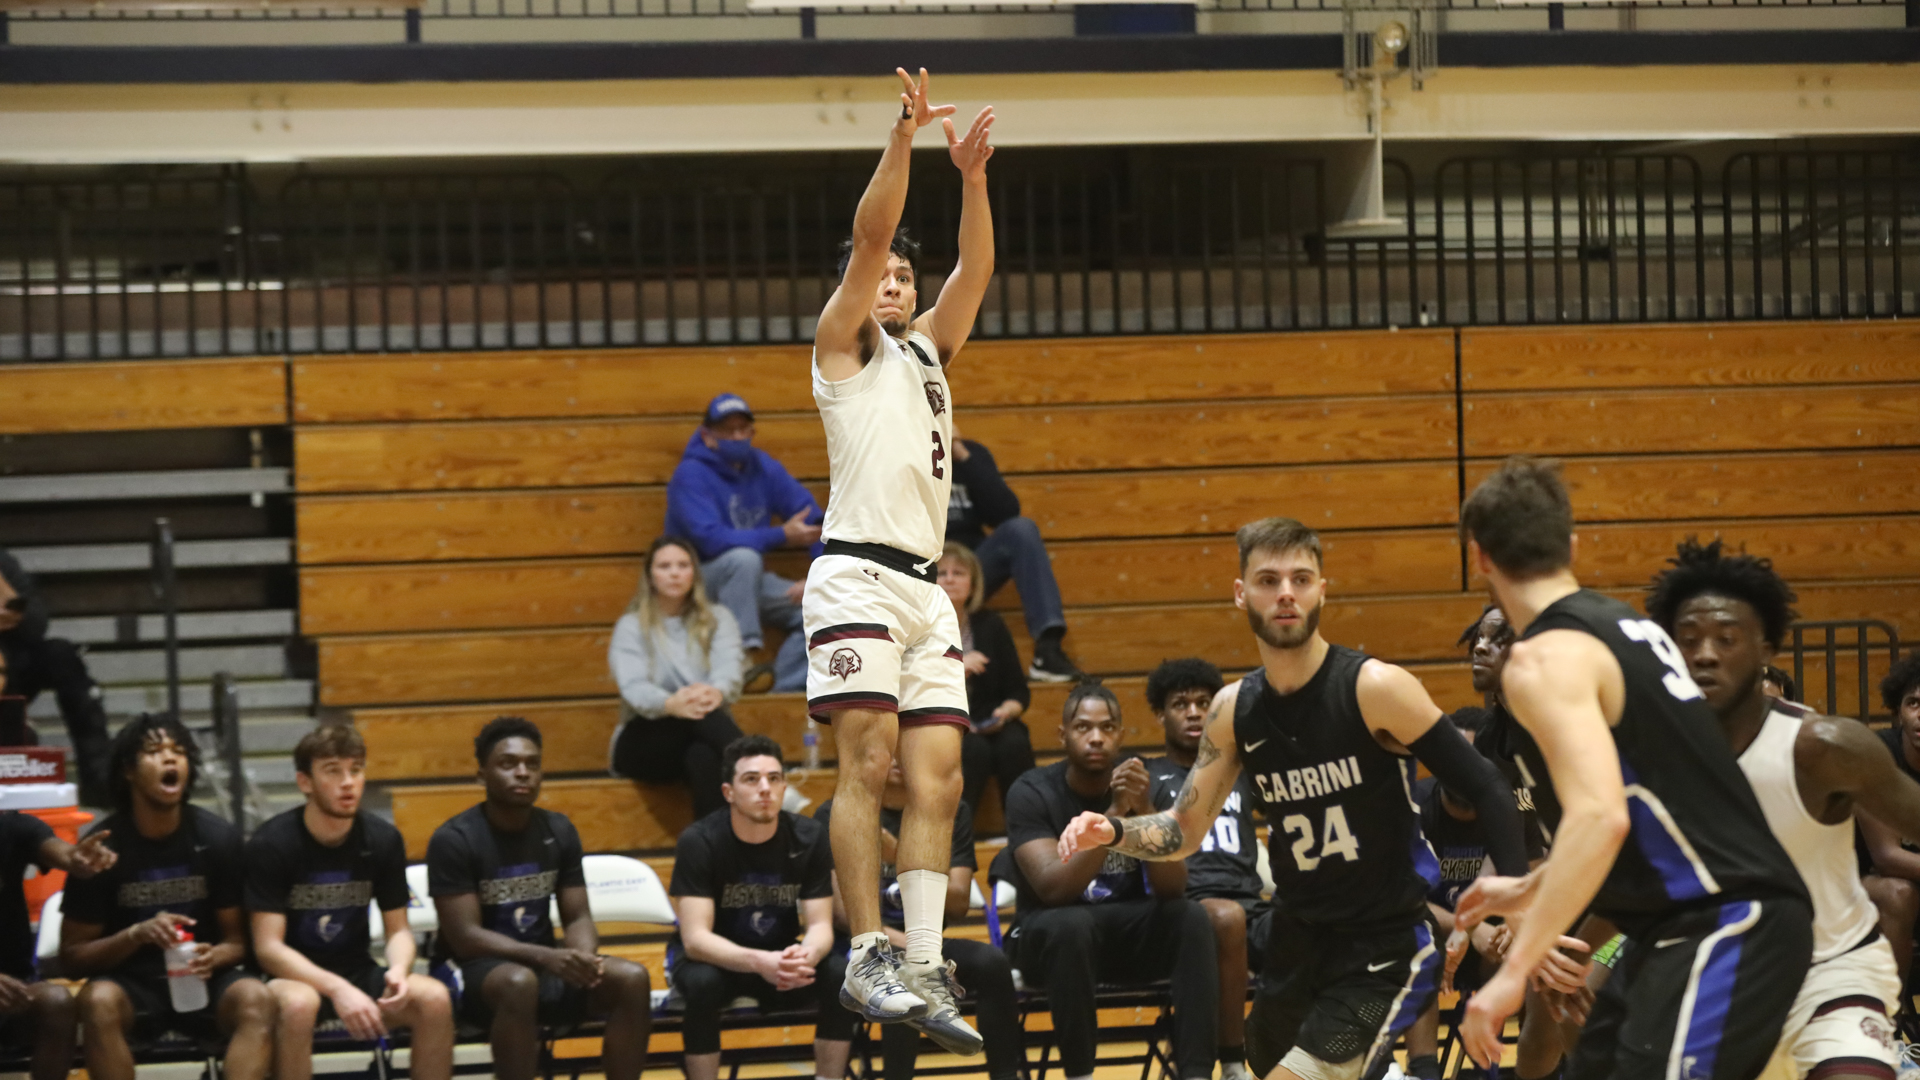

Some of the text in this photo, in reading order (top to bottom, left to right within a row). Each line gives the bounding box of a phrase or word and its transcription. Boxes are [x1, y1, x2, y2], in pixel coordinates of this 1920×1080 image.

[931, 430, 945, 480] 2
[1255, 756, 1362, 803] CABRINI
[1282, 805, 1359, 871] 24
